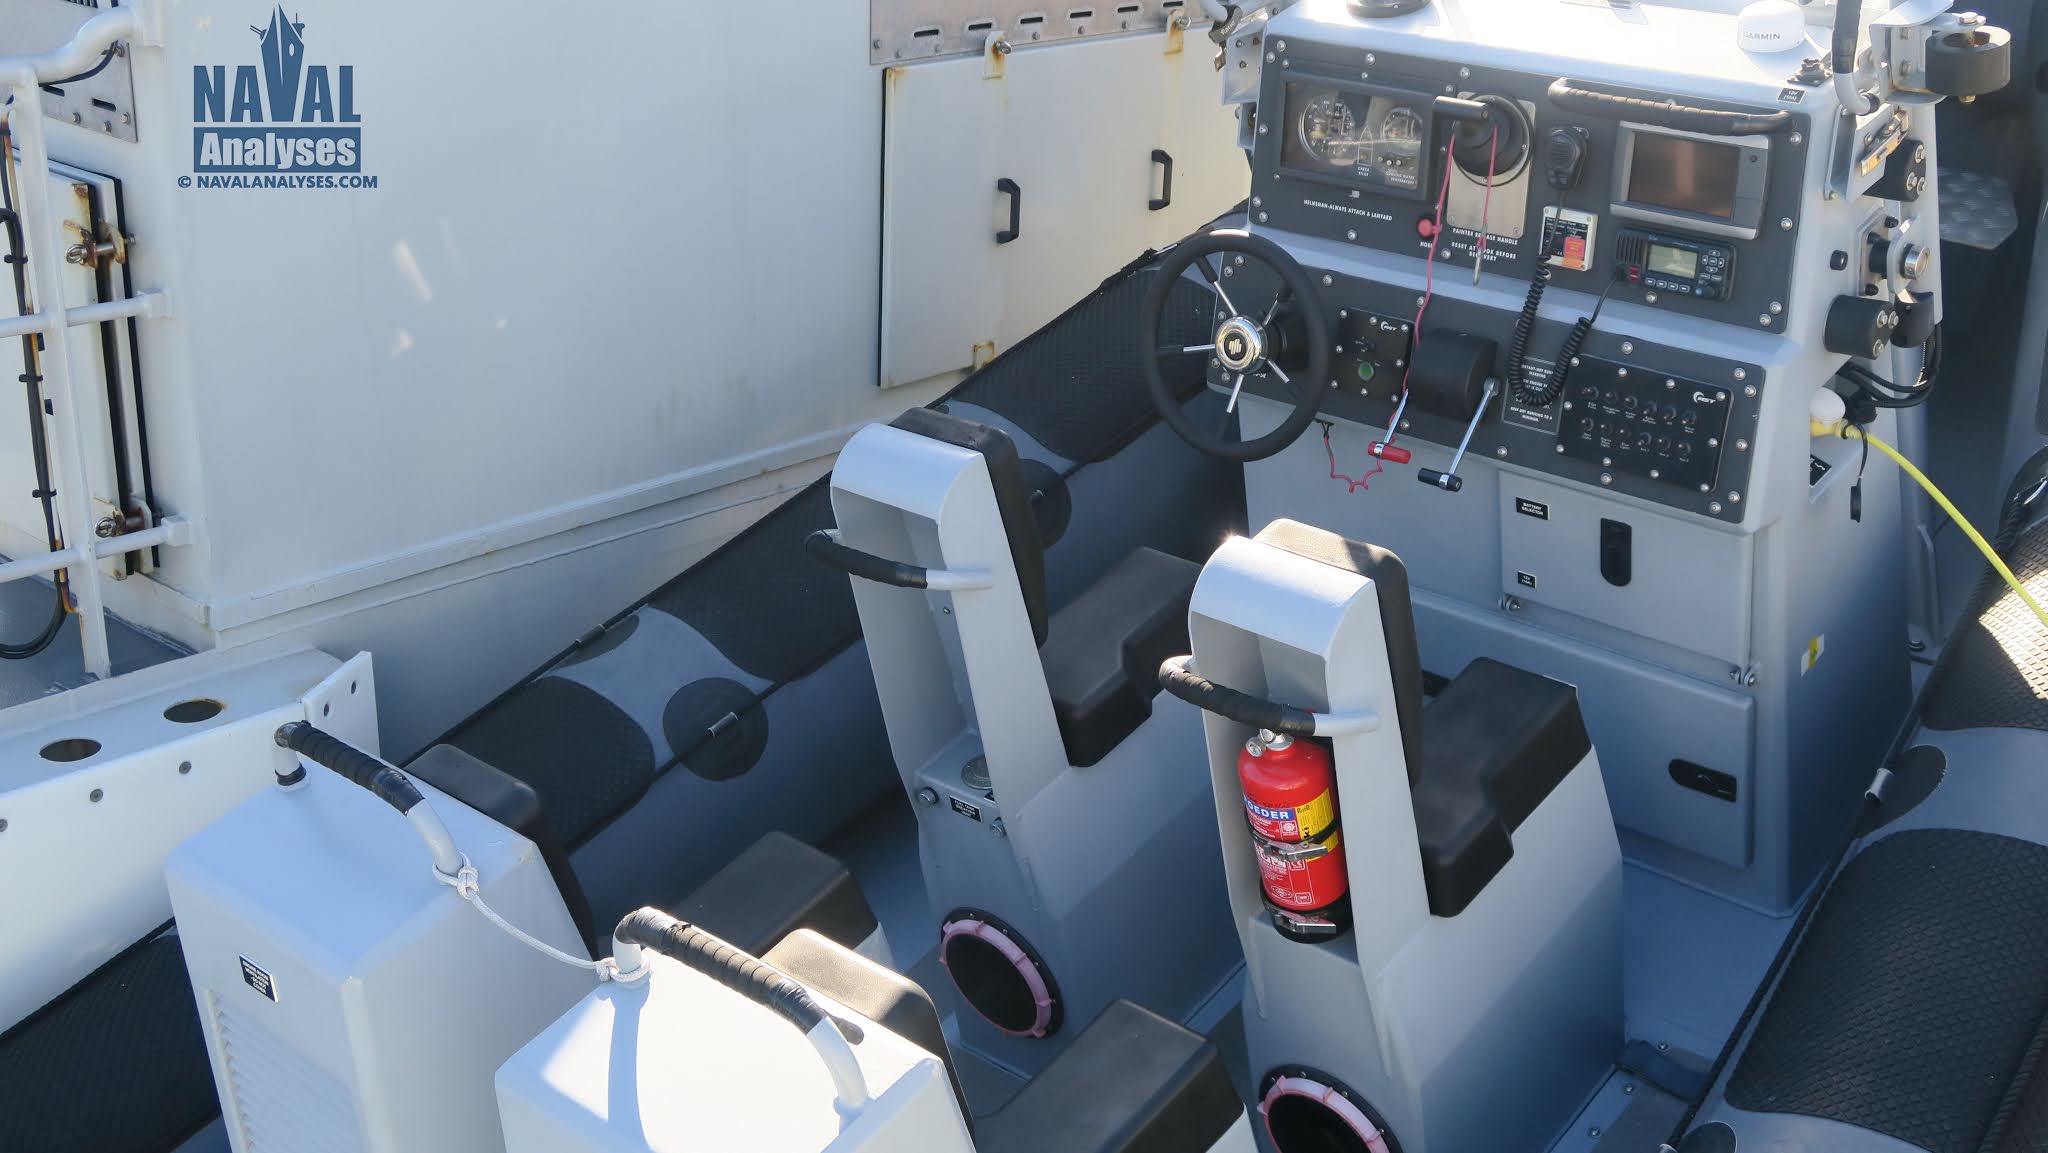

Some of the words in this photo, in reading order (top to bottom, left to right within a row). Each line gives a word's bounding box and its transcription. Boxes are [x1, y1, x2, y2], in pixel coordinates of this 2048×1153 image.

[1743, 32, 1780, 40] GARMIN
[1348, 207, 1366, 216] ATTACH
[1371, 212, 1393, 221] LANYARD
[1452, 227, 1474, 237] PAINTER
[1497, 236, 1518, 246] HANDLE
[1451, 241, 1467, 250] RESET
[1495, 251, 1517, 260] BEFORE
[1521, 506, 1544, 516] SELECTOR
[1523, 502, 1542, 511] BATTERY
